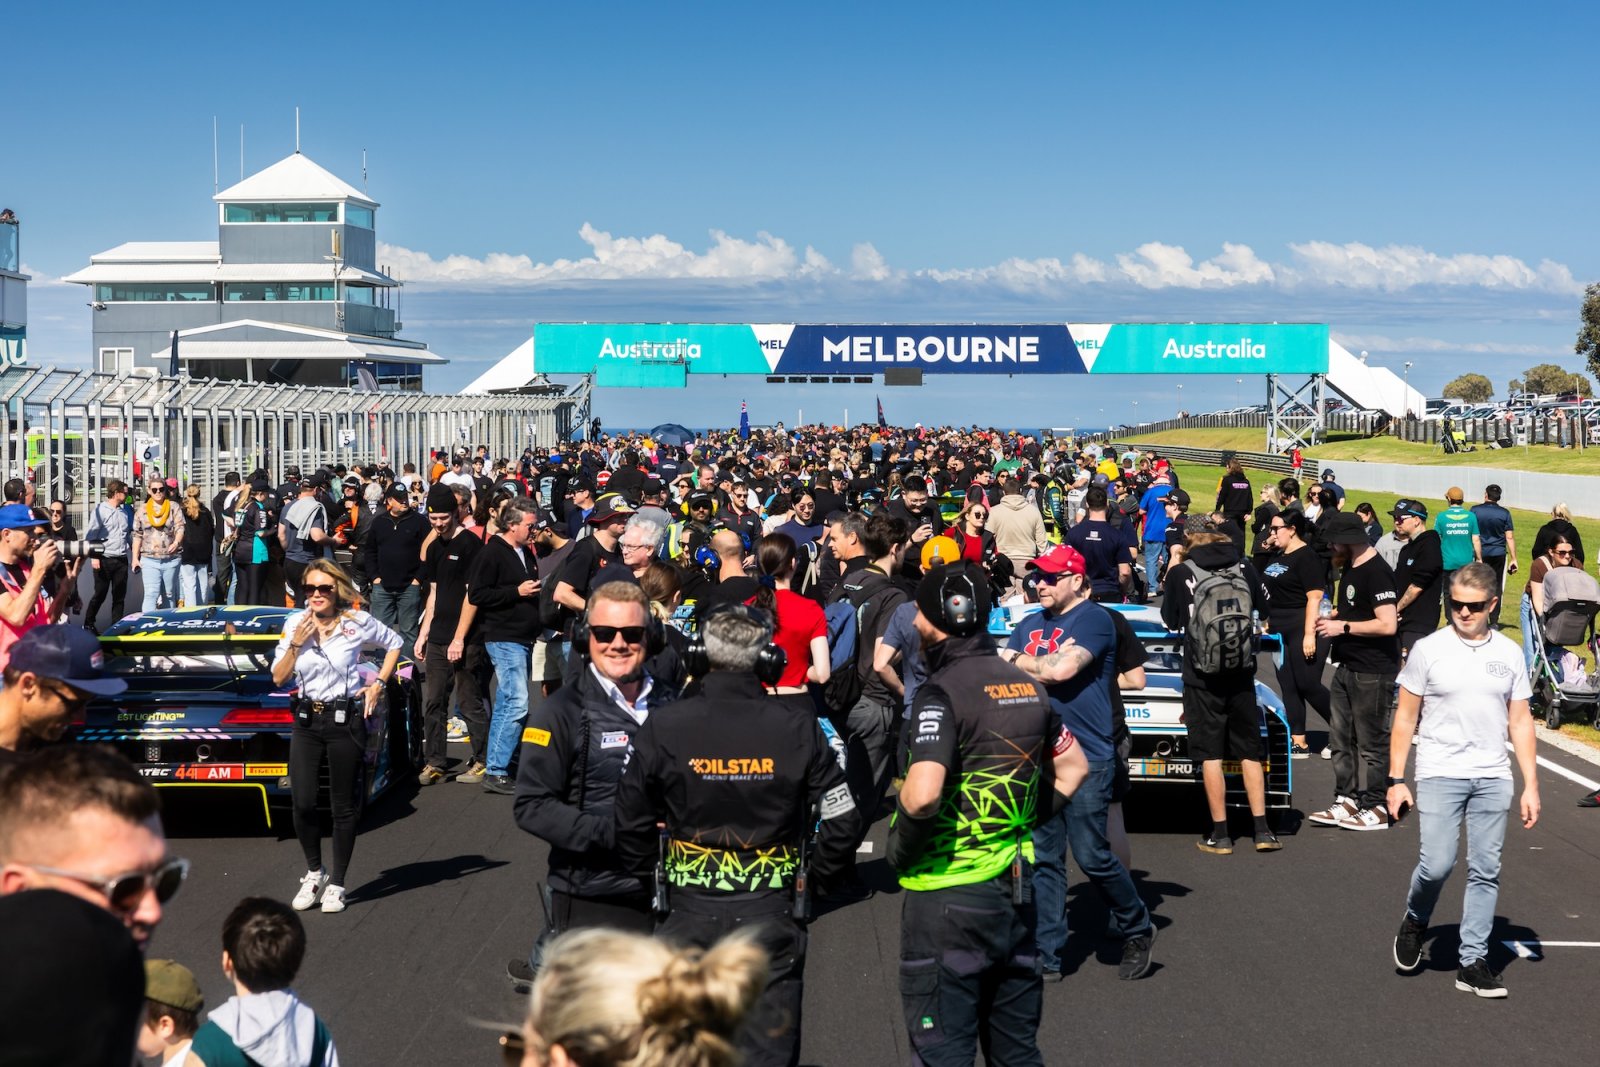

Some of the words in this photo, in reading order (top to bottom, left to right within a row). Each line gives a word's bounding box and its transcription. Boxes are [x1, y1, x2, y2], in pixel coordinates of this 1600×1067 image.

[598, 338, 701, 359] Australia
[759, 339, 786, 350] MEL
[823, 336, 1039, 363] MELBOURNE
[1075, 339, 1102, 350] MEL
[1162, 338, 1266, 359] Australia
[343, 435, 351, 446] 5
[143, 446, 152, 460] 6
[1222, 604, 1241, 669] GLOBE
[984, 682, 1038, 700] OILSTAR
[1124, 707, 1151, 719] ans
[175, 763, 197, 779] 44
[207, 767, 231, 779] AM
[689, 758, 775, 775] OILSTAR
